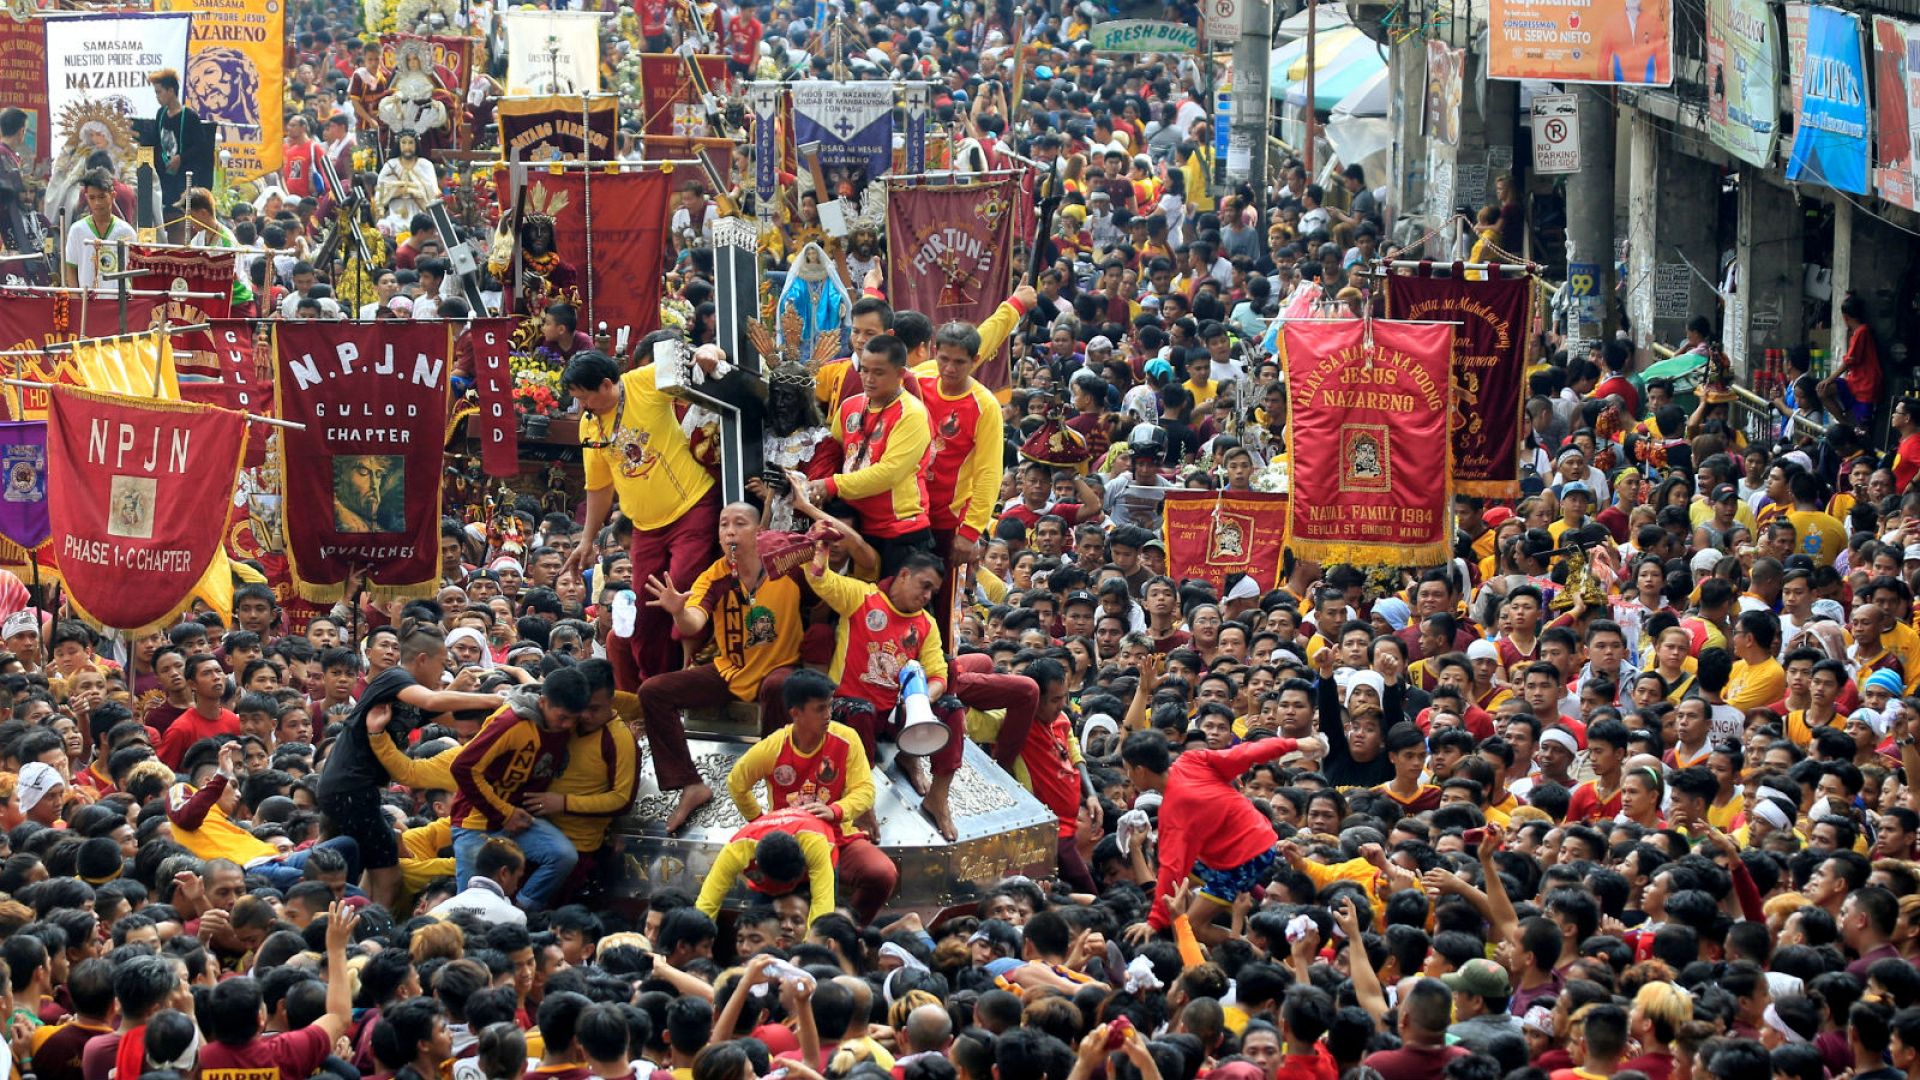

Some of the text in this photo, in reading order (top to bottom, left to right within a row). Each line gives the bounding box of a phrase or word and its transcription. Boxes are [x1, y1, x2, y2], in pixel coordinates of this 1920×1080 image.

[193, 0, 245, 8] SAMASAMA
[242, 14, 266, 23] JESUS
[1503, 20, 1557, 29] CONGRESSMAN
[192, 25, 267, 42] AZARENO
[1105, 25, 1155, 48] FRESH
[1503, 29, 1591, 44] YUL SERVO NIETO
[83, 41, 143, 51] SAMASAMA
[64, 54, 162, 67] NUESTRO PADRE JESUS
[65, 71, 153, 89] NAZAREN
[222, 158, 263, 169] ESITA
[1537, 151, 1577, 160] PARKING
[912, 228, 992, 276] FORTUNE
[1572, 274, 1592, 296] 99
[1297, 370, 1325, 408] ALAY
[1319, 354, 1340, 374] SA
[1391, 351, 1411, 371] NA
[1408, 363, 1443, 411] POONG
[1340, 367, 1398, 385] JESUS
[485, 332, 503, 442] GULOD
[316, 403, 417, 416] GULOD
[1323, 390, 1415, 412] NAZARENO
[327, 428, 410, 443] CHAPTER
[1310, 504, 1433, 523] NAVAL FAMILY 1984
[64, 534, 110, 565] PHASE
[136, 547, 191, 571] CHAPTER
